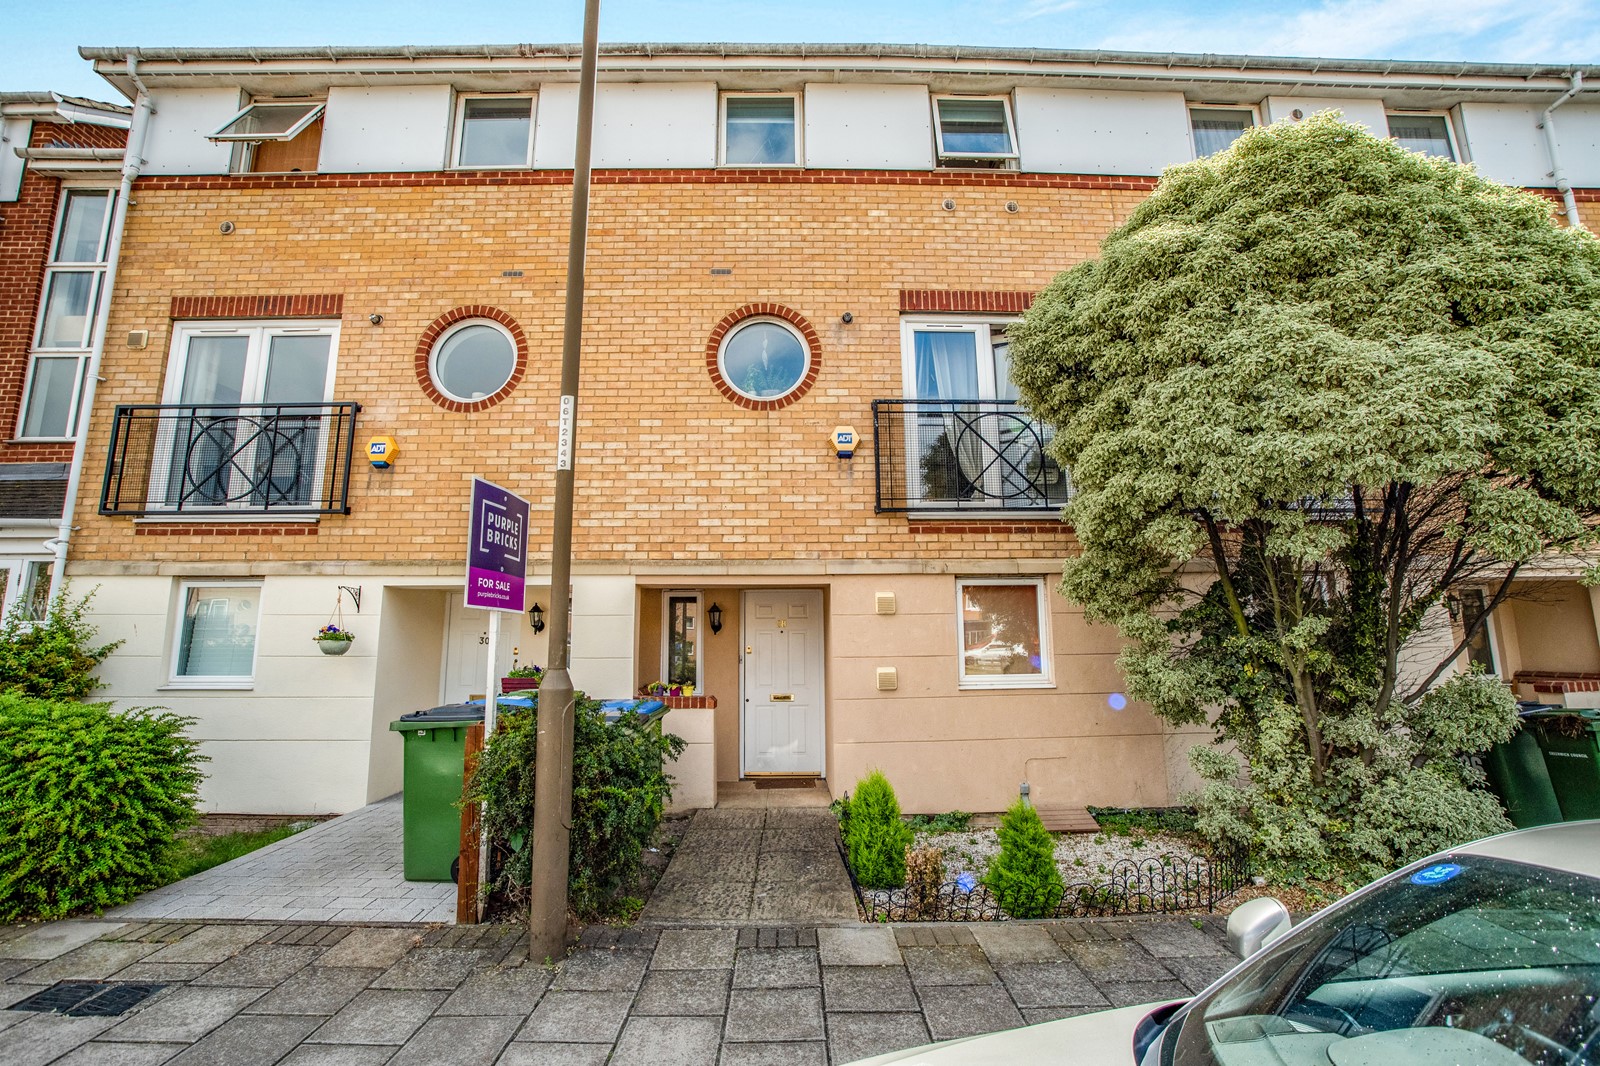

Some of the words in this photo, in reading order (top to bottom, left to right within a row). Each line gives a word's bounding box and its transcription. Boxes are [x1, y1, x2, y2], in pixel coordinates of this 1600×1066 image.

[560, 397, 570, 467] 06T2343
[837, 434, 852, 442] ADT
[371, 444, 386, 453] ADT
[487, 512, 519, 535] PURPLE
[486, 529, 518, 550] BRICKS
[478, 577, 494, 589] FOR
[495, 580, 511, 592] SALE
[477, 591, 510, 601] purplebricks.co.uk
[479, 636, 489, 645] 30
